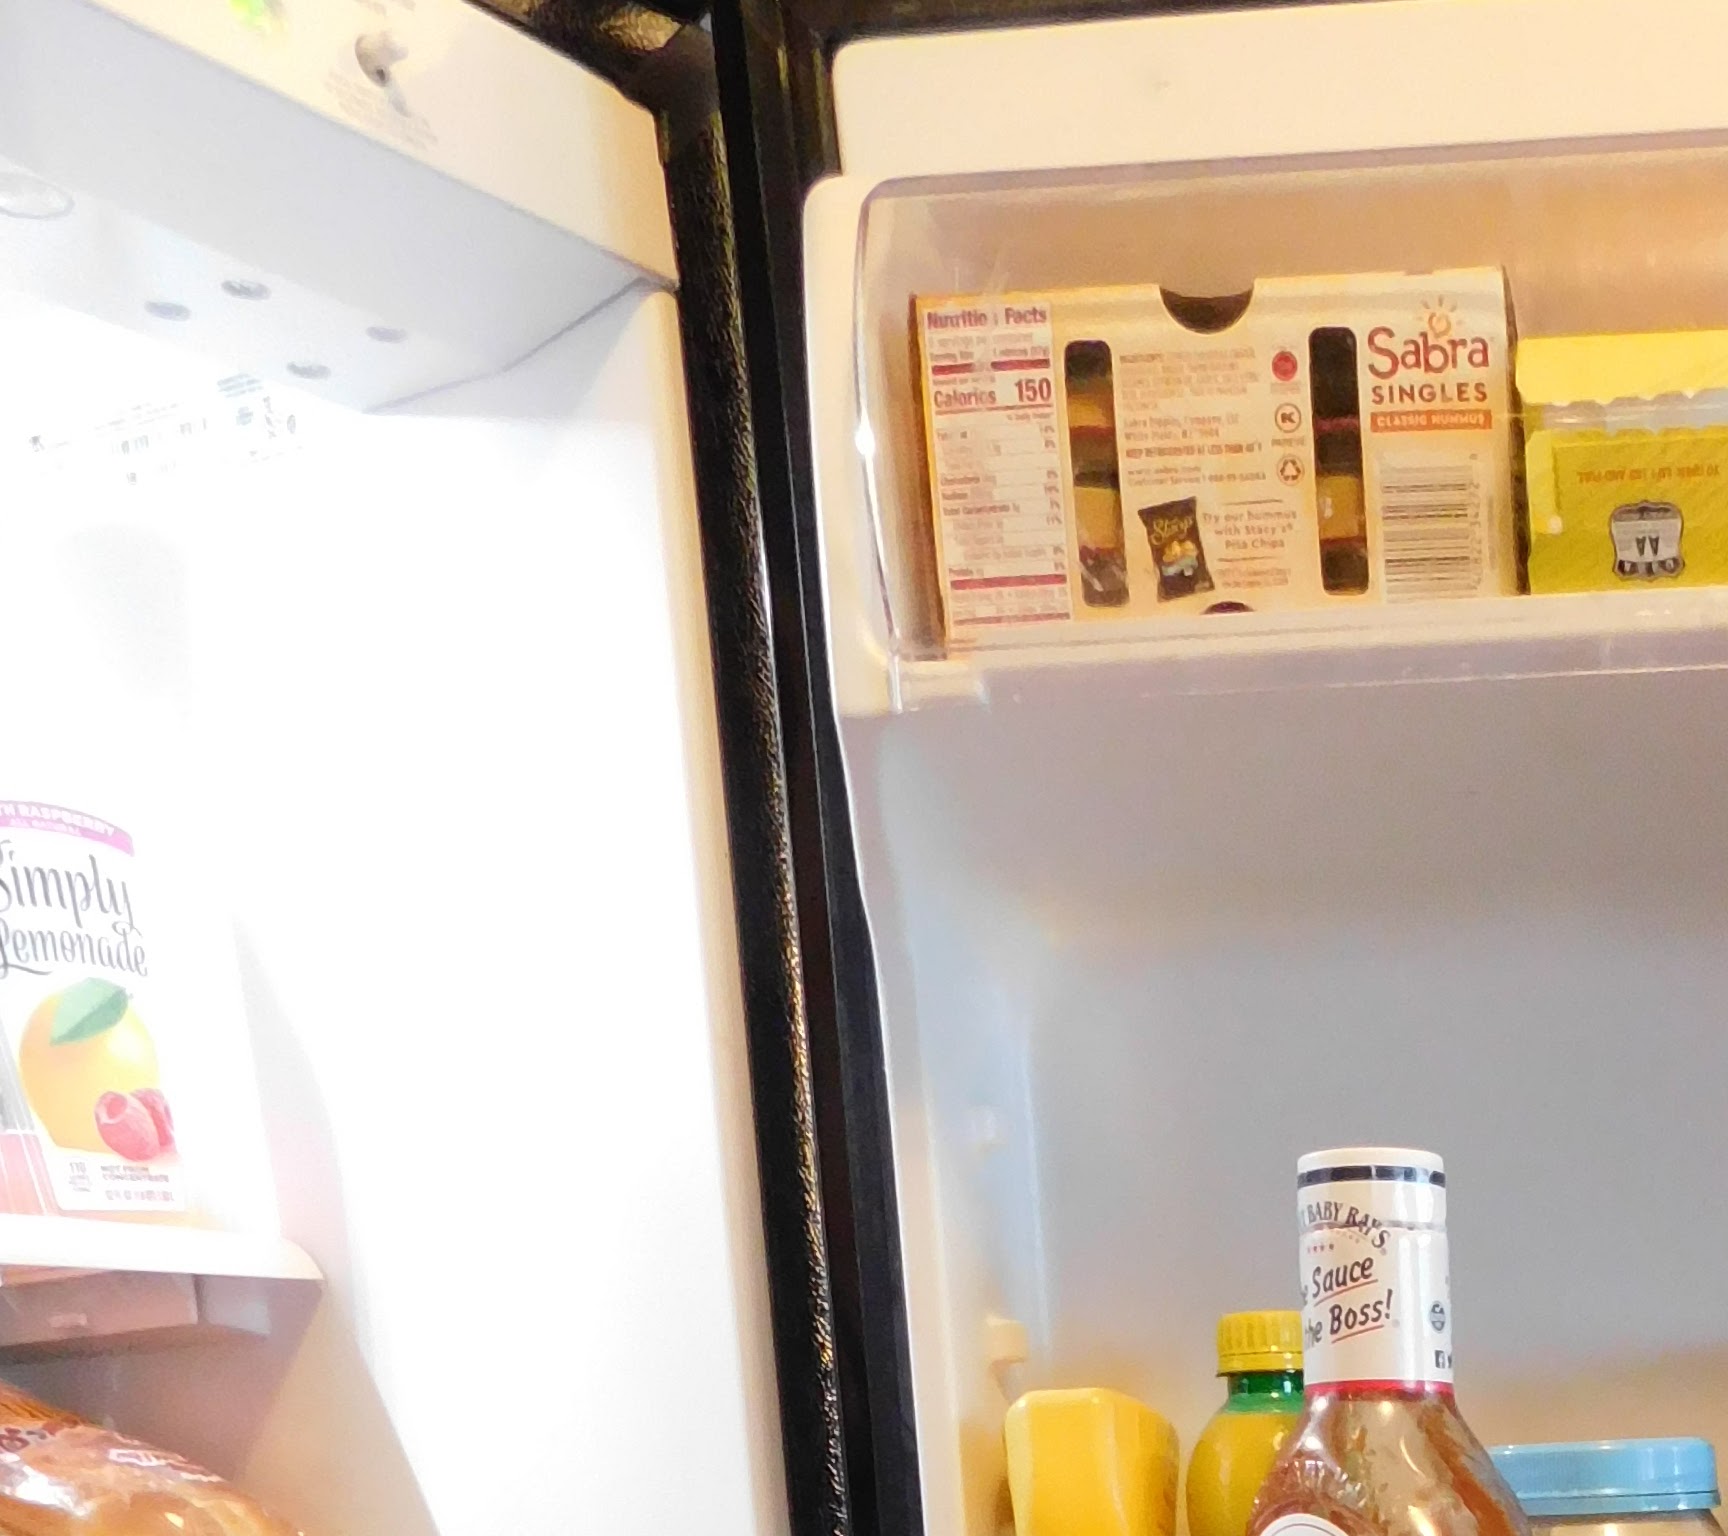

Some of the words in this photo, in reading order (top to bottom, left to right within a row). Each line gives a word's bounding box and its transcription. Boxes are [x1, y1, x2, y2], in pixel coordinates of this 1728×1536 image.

[1005, 307, 1047, 324] Facts
[1368, 326, 1490, 380] Sabra
[934, 387, 997, 408] Calories
[1015, 377, 1052, 403] 150
[1371, 382, 1488, 406] SINGLES
[1377, 413, 1427, 427] CLASSIC
[1312, 1256, 1375, 1298] Sauce
[1328, 1288, 1394, 1335] Boss!
